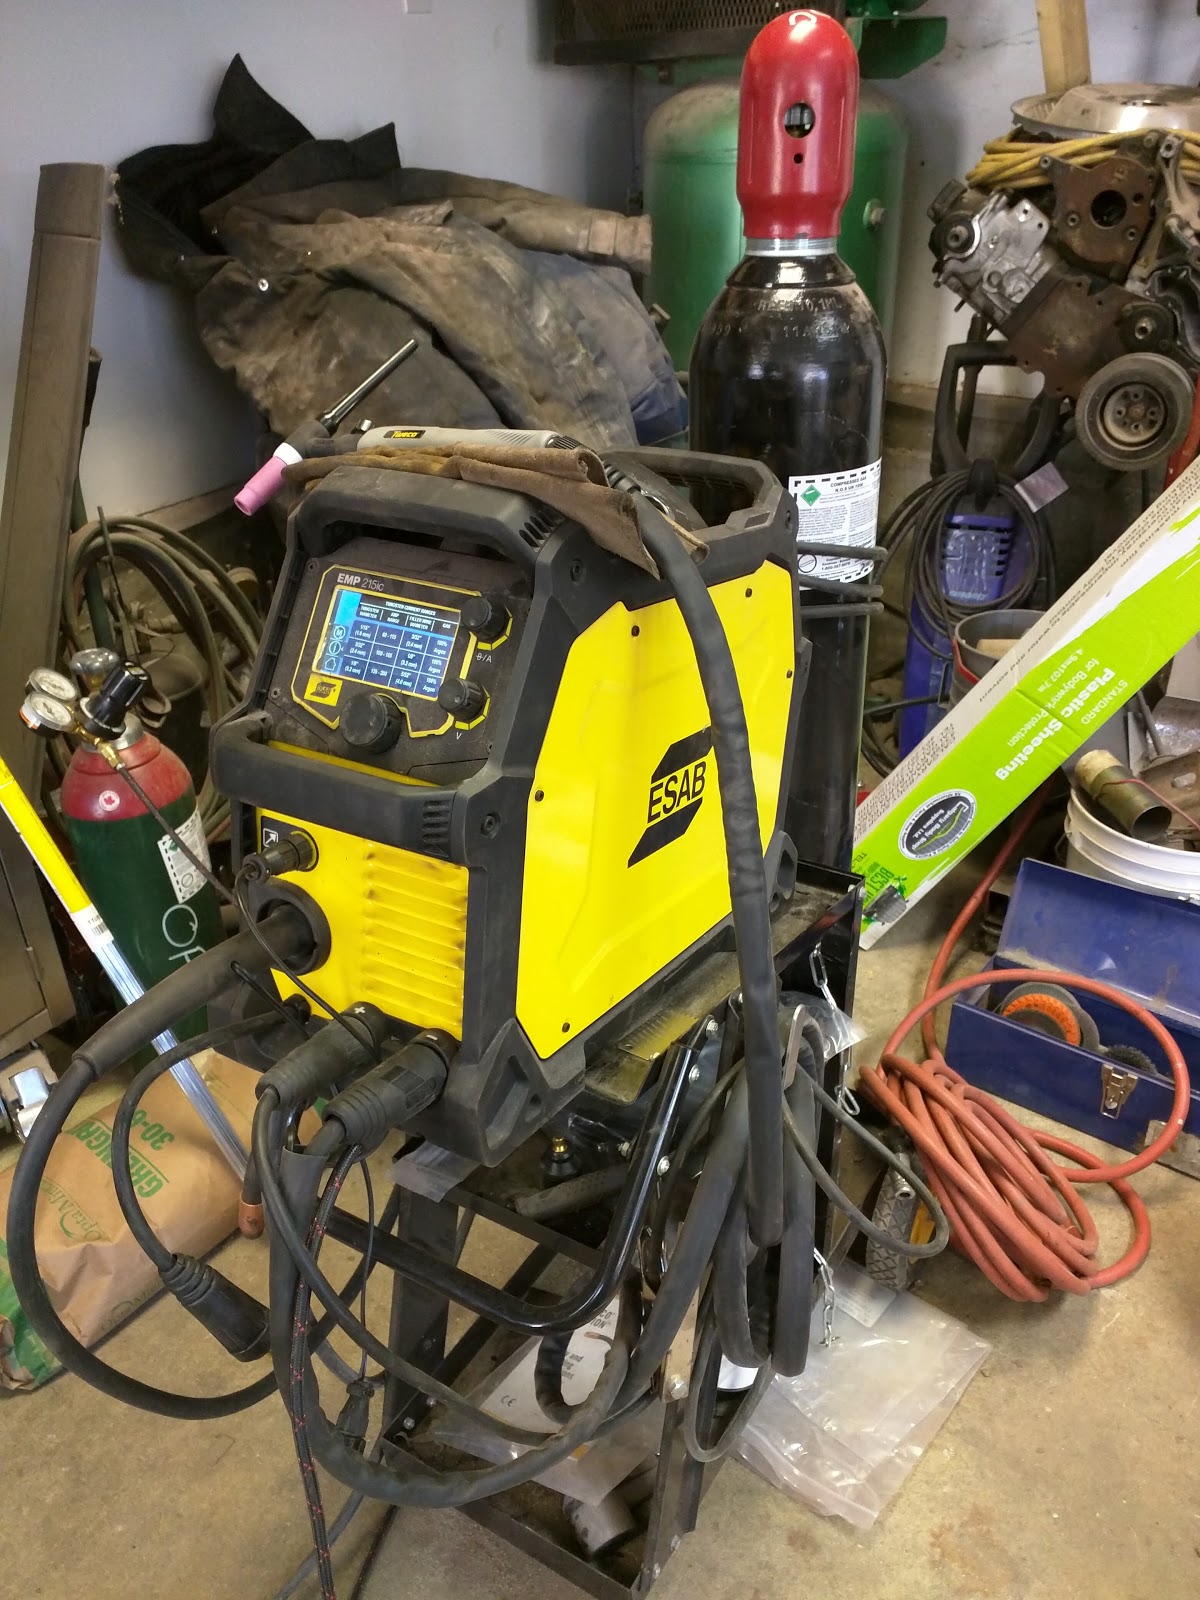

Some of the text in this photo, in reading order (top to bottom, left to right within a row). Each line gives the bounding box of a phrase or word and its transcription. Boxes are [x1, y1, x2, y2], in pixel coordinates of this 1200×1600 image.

[391, 430, 418, 439] Tweco
[337, 573, 385, 592] EMP 215ic
[432, 647, 446, 656] Argon
[427, 666, 441, 674] Argon
[422, 684, 435, 693] Argon
[1006, 656, 1100, 749] for Bodywork Protection
[1059, 665, 1115, 721] Plastic
[1079, 678, 1128, 726] STANDARD
[455, 731, 463, 741] V
[993, 714, 1063, 784] Sheeting
[647, 760, 707, 824] ESAB
[910, 798, 969, 851] Calgary Body Shop
[912, 807, 944, 840] Supplies Ltd.
[865, 866, 894, 891] BEST
[128, 1106, 175, 1151] 30-6
